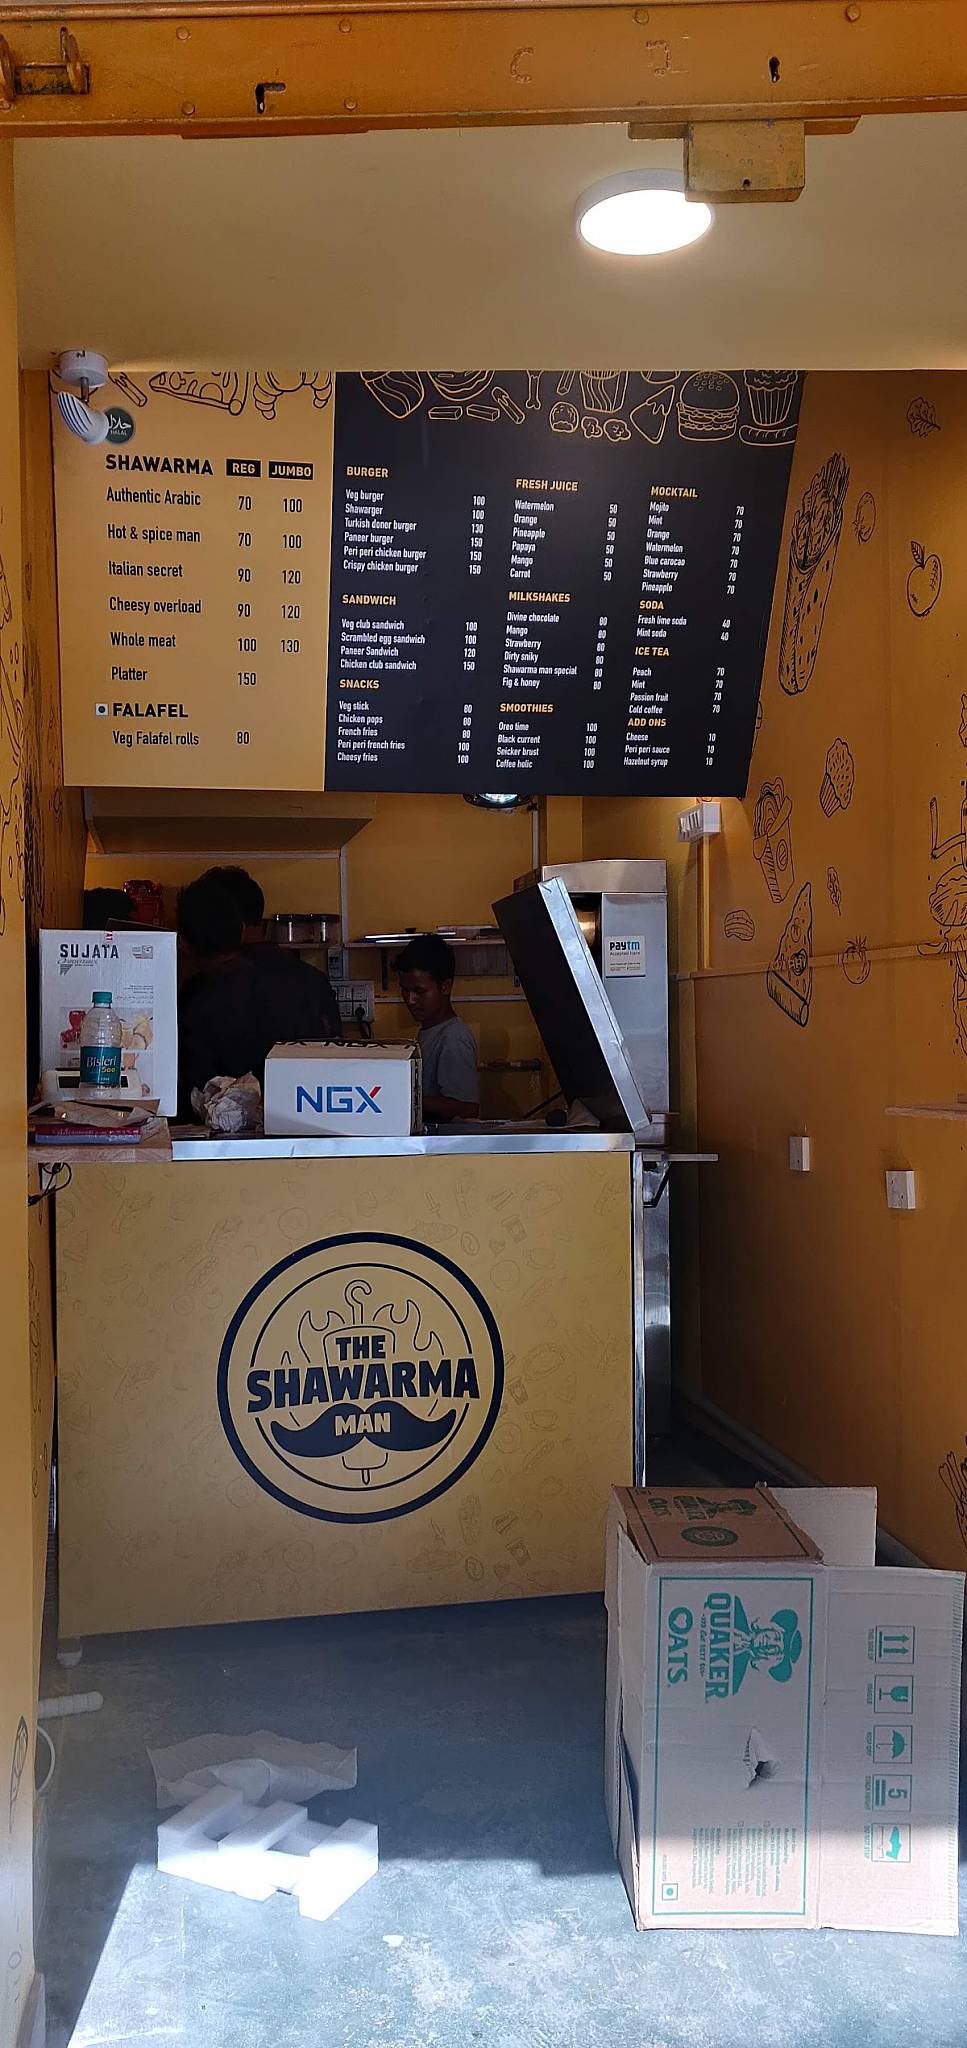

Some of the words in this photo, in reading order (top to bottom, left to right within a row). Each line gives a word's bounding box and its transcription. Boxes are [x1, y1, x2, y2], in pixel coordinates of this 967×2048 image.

[105, 454, 213, 476] SHAWARMA
[231, 463, 256, 474] REG
[271, 464, 312, 478] JUMBO
[346, 466, 389, 478] BURGER
[516, 479, 548, 490] FRESH
[550, 481, 578, 492] JUICE
[345, 489, 358, 501] Veg
[360, 490, 384, 502] burger
[473, 496, 485, 506] 100
[651, 486, 698, 498] MOCKTAIL
[106, 487, 161, 504] Authentic
[164, 491, 201, 506] Arabic
[238, 496, 252, 511] 70
[283, 498, 302, 513] 100
[345, 504, 383, 517] Shawarger
[472, 510, 485, 520] 100
[514, 500, 554, 512] Watermelon
[609, 504, 618, 514] 50
[736, 506, 745, 516] 70
[608, 518, 616, 527] 50
[648, 515, 663, 525] Mint
[734, 519, 743, 529] 70
[107, 525, 126, 541] Hot
[129, 527, 139, 540] &
[142, 527, 173, 544] spice
[176, 531, 201, 543] man
[238, 533, 251, 547] 70
[282, 534, 302, 549] 100
[513, 527, 545, 540] Pineapple
[607, 532, 615, 541] 50
[733, 533, 741, 542] 70
[470, 537, 483, 547] 150
[512, 541, 535, 553] Papaya
[606, 545, 614, 554] 50
[344, 546, 358, 556] Peri
[359, 547, 373, 558] peri
[375, 547, 401, 558] chicken
[403, 548, 426, 561] burger
[470, 551, 482, 561] 150
[646, 542, 683, 553] Watermelon
[731, 546, 740, 555] 70
[343, 560, 365, 572] Crispy
[367, 561, 393, 572] chicken
[395, 562, 418, 574] burger
[469, 565, 481, 575] 150
[511, 555, 533, 567] Mango
[604, 558, 613, 568] 50
[730, 559, 738, 569] 70
[108, 561, 143, 577] Italian
[147, 564, 183, 578] secret
[238, 568, 251, 583] 90
[282, 569, 301, 584] 120
[510, 568, 531, 578] Carrot
[603, 571, 611, 581] 50
[643, 569, 678, 581] Strawberry
[728, 572, 736, 582] 70
[727, 585, 735, 595] 70
[342, 595, 397, 606] SANDWICH
[508, 591, 571, 603] MILKSHAKES
[109, 597, 150, 615] Cheesy
[153, 599, 201, 614] overload
[237, 603, 251, 618] 90
[281, 605, 301, 620] 120
[639, 600, 664, 610] SODA
[507, 612, 527, 622] Divine
[529, 612, 560, 623] chocolate
[638, 615, 655, 625] Fresh
[722, 619, 730, 628] 40
[506, 625, 528, 637] Mango
[720, 632, 729, 641] 40
[110, 632, 145, 647] Whole
[148, 634, 176, 648] meat
[237, 638, 257, 652] 100
[280, 639, 300, 654] 130
[341, 632, 377, 643] Scrambled
[379, 634, 392, 645] egg
[393, 634, 425, 644] sandwich
[505, 638, 541, 650] Strawberry
[340, 646, 364, 656] Paneer
[366, 646, 398, 657] Sandwich
[464, 648, 476, 658] 120
[504, 651, 520, 662] Dirty
[521, 652, 538, 663] sniky
[635, 647, 650, 656] ICE
[652, 647, 669, 656] TEA
[340, 658, 367, 669] Chicken
[369, 659, 383, 669] club
[385, 660, 416, 670] sandwich
[463, 661, 475, 671] 150
[504, 664, 537, 675] Shawarma
[539, 667, 553, 675] man
[554, 666, 577, 676] special
[111, 667, 148, 682] Platter
[237, 672, 257, 686] 150
[633, 667, 652, 676] Peach
[717, 667, 725, 676] 70
[339, 679, 380, 689] SNACKS
[632, 680, 646, 689] Mint
[715, 680, 723, 689] 70
[630, 692, 654, 701] Passion
[655, 692, 668, 702] fruit
[714, 692, 722, 701] 70
[113, 703, 189, 718] FALAFEL
[500, 703, 554, 713] SMOOTHIES
[629, 705, 643, 714] Cold
[644, 705, 663, 714] coffee
[712, 705, 720, 713] 70
[338, 714, 365, 724] Chicken
[367, 716, 383, 725] pops
[628, 718, 646, 727] ADD
[648, 718, 667, 727] ONS
[338, 727, 361, 736] French
[362, 727, 378, 736] fries
[586, 723, 598, 732] 100
[113, 731, 134, 747] Veg
[136, 730, 173, 745] Falafel
[175, 731, 200, 746] rolls
[237, 731, 250, 745] 80
[498, 735, 515, 743] Black
[517, 735, 540, 744] current
[585, 735, 596, 744] 100
[626, 732, 648, 741] Cheese
[338, 740, 352, 749] Peri
[353, 740, 366, 751] peri
[367, 740, 388, 750] french
[390, 741, 405, 750] fries
[458, 742, 470, 751] 100
[584, 748, 595, 757] 100
[458, 754, 469, 764] 100
[496, 759, 516, 768] Coffee
[517, 760, 533, 768] holic
[583, 760, 594, 769] 100
[706, 758, 713, 766] 10
[60, 944, 119, 958] SUJATA
[610, 941, 640, 950] paytm
[86, 1056, 116, 1068] Bisleri
[297, 1086, 382, 1113] NGX
[336, 1335, 386, 1361] THE
[247, 1357, 480, 1414] SHAWARMA
[335, 1412, 391, 1436] MAN
[667, 1607, 693, 1687] OATS
[704, 1592, 731, 1703] QUAKER
[888, 1788, 908, 1799] 5
